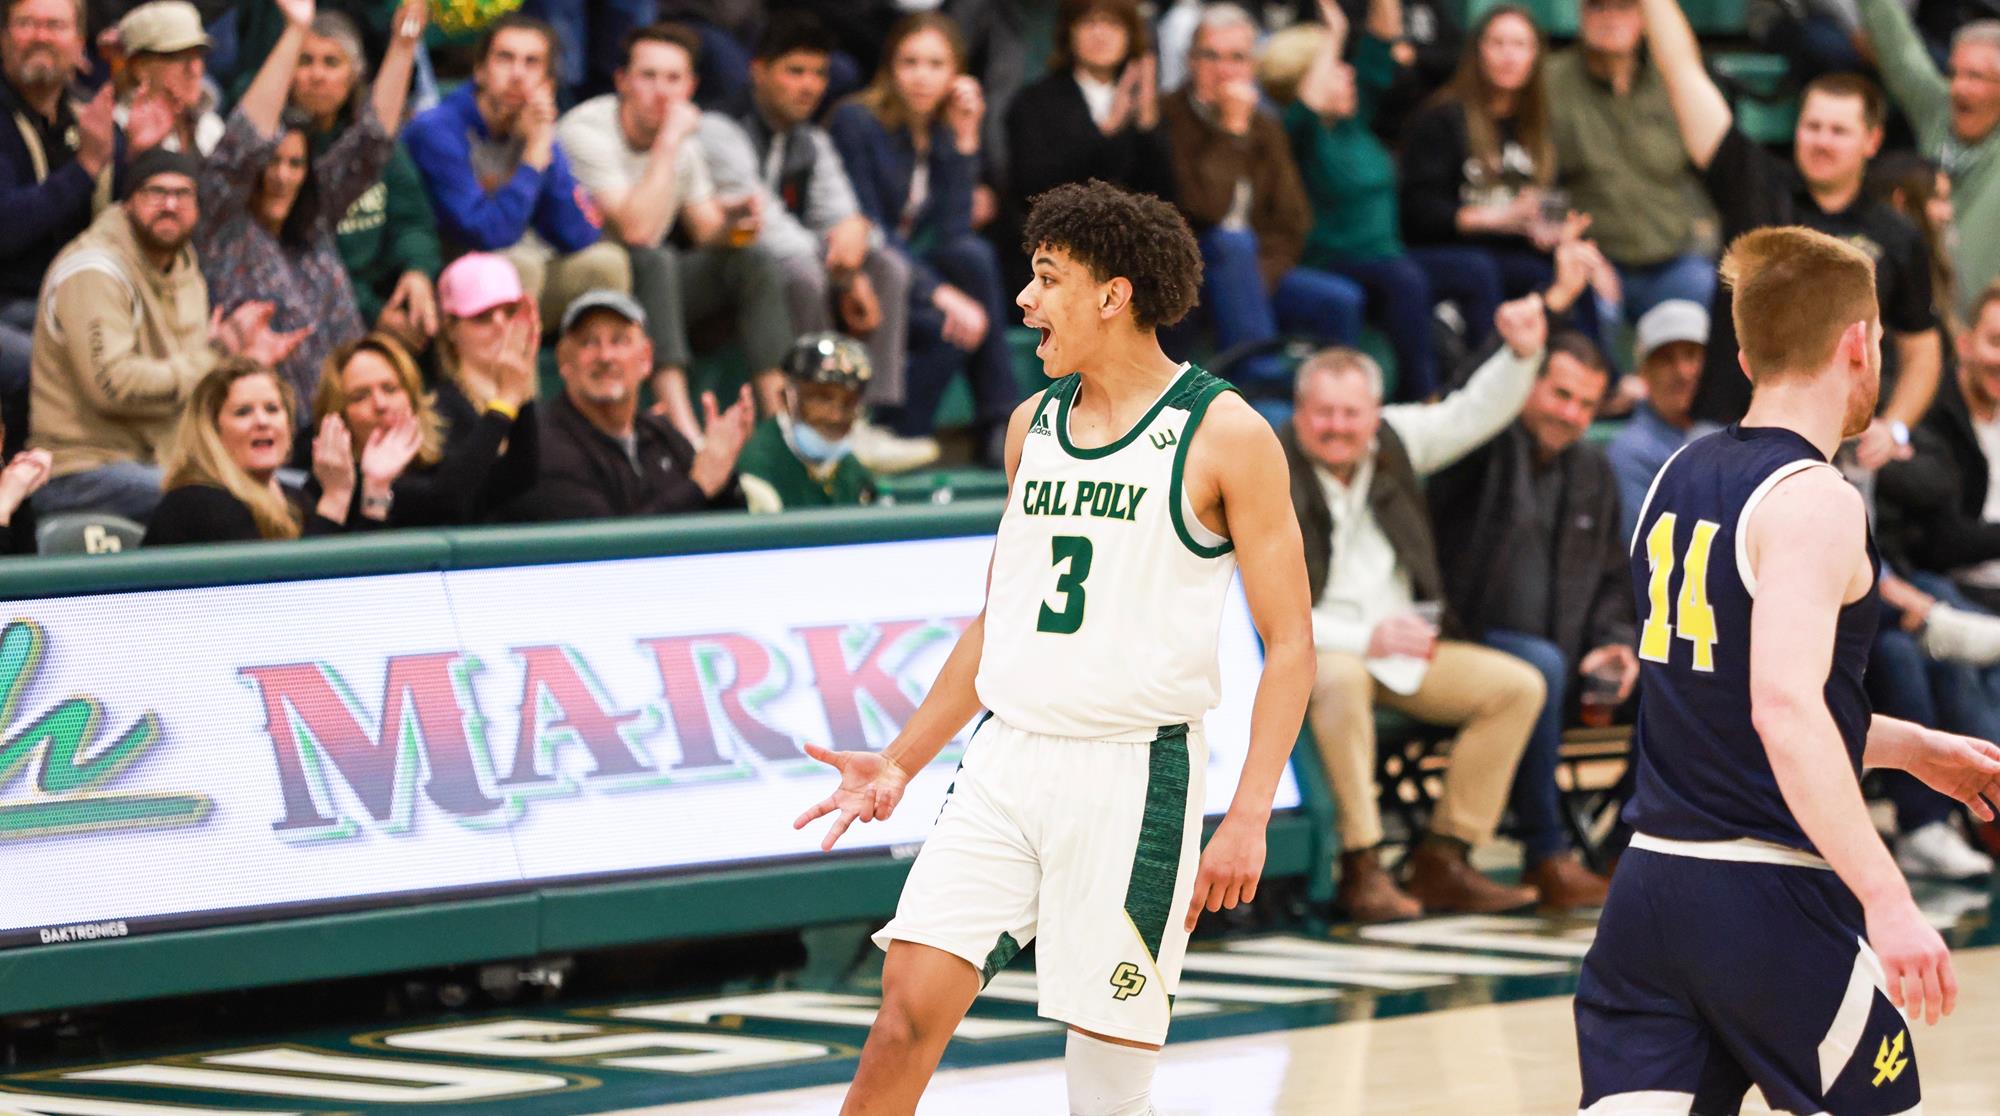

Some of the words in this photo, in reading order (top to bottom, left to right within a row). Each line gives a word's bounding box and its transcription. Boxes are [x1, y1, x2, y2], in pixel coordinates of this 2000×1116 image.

[1022, 480, 1067, 516] CAL
[1071, 480, 1148, 521] POLY
[1036, 535, 1094, 635] 3
[1638, 511, 1721, 672] 14
[236, 614, 988, 846] MARK
[40, 921, 128, 944] DAKTRONICS
